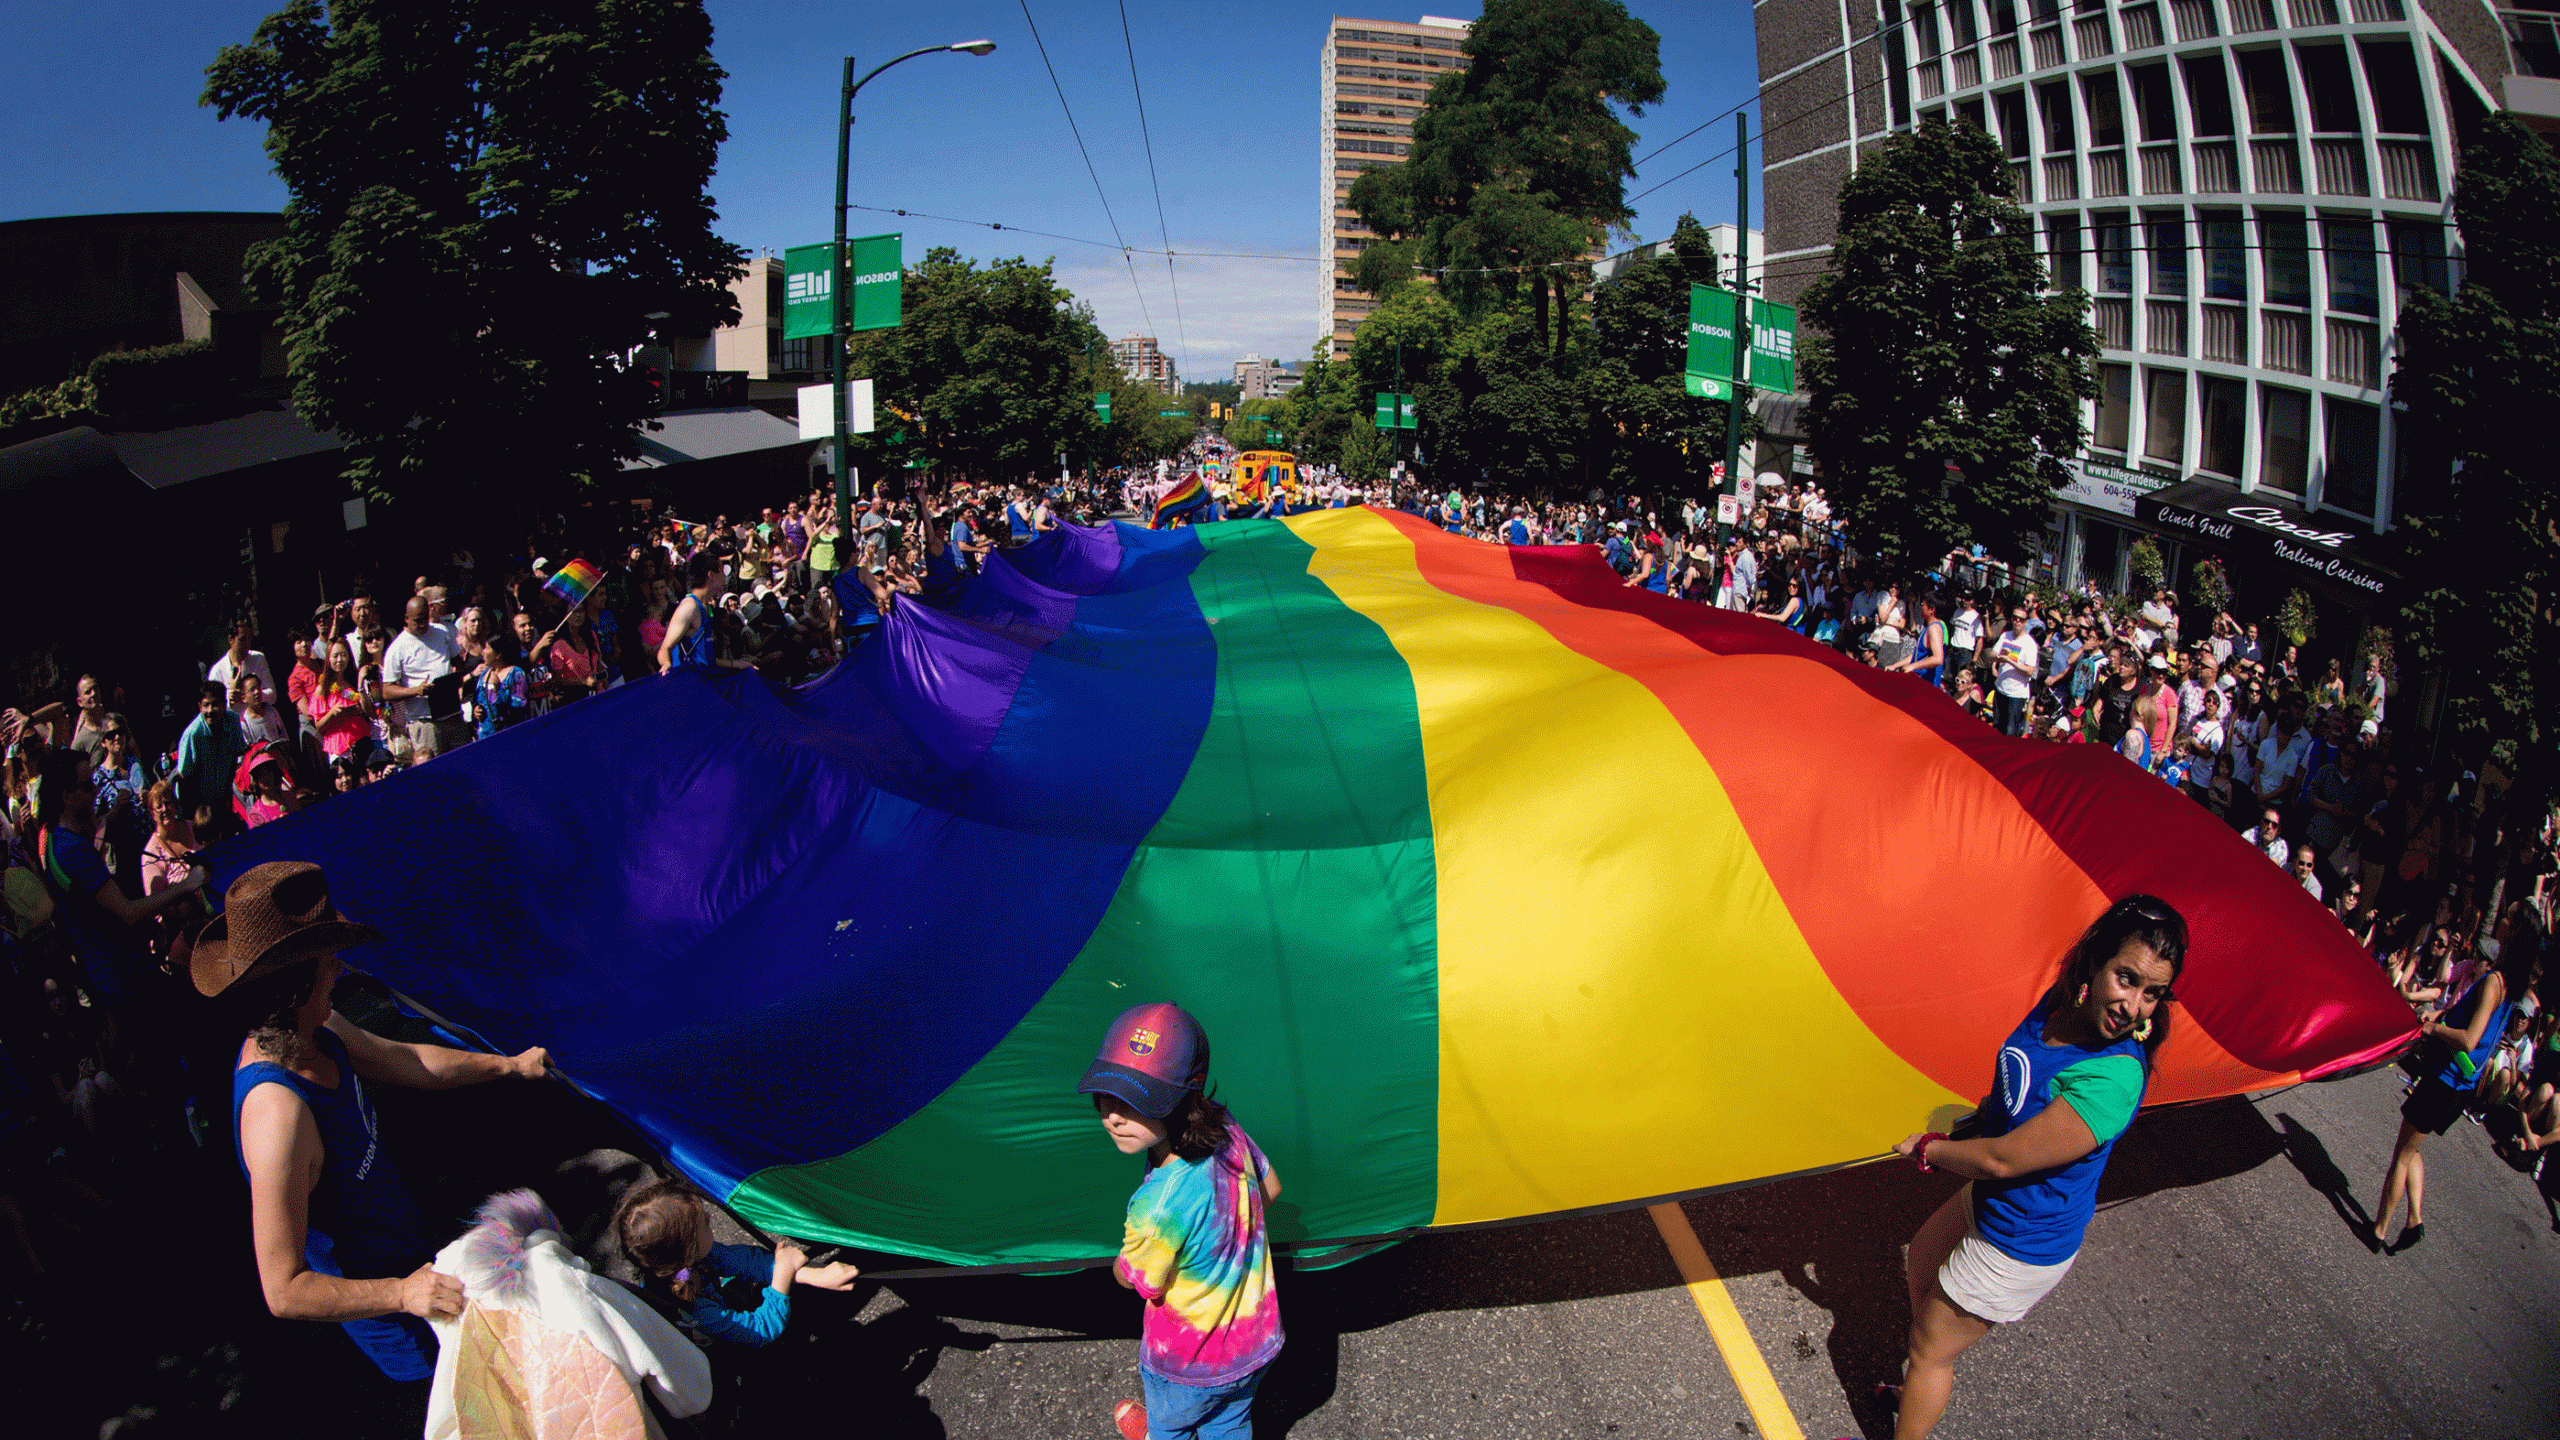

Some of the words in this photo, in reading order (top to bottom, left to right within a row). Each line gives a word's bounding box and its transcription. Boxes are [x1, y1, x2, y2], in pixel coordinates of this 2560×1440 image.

[1754, 347, 1764, 355] THE
[1765, 350, 1780, 358] WEST
[2103, 483, 2144, 500] 604-558
[2158, 506, 2196, 529] Cinch
[2199, 518, 2234, 540] Grill
[2274, 539, 2324, 571] Italian
[2325, 559, 2384, 593] Cuisine
[356, 1140, 377, 1181] VISION
